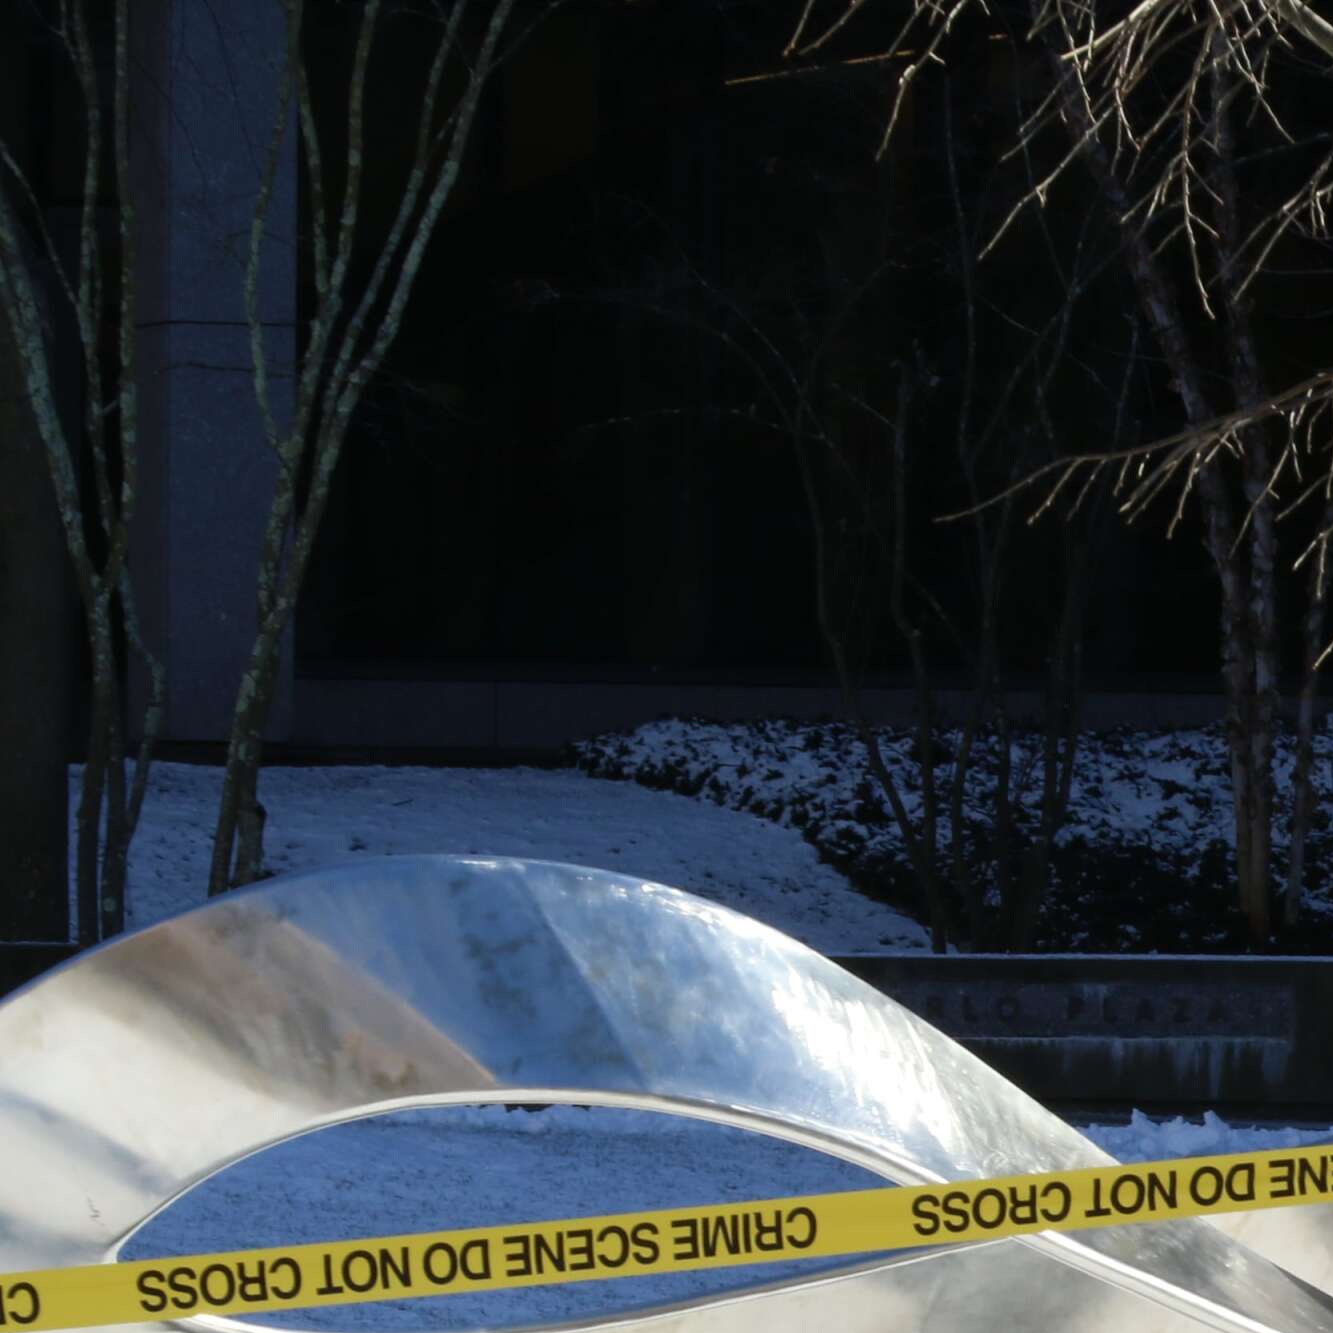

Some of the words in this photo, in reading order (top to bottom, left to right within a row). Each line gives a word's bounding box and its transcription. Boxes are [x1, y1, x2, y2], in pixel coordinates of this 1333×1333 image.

[1066, 995, 1231, 1026] PLAZA
[911, 1181, 1072, 1236] CROSS
[1084, 1170, 1178, 1218] NOT
[1189, 1162, 1256, 1207] DO
[502, 1222, 660, 1278] SCENE
[670, 1206, 817, 1261] CRIME
[136, 1257, 302, 1313] CROSS
[316, 1246, 412, 1296] NOT
[422, 1238, 492, 1286] DO
